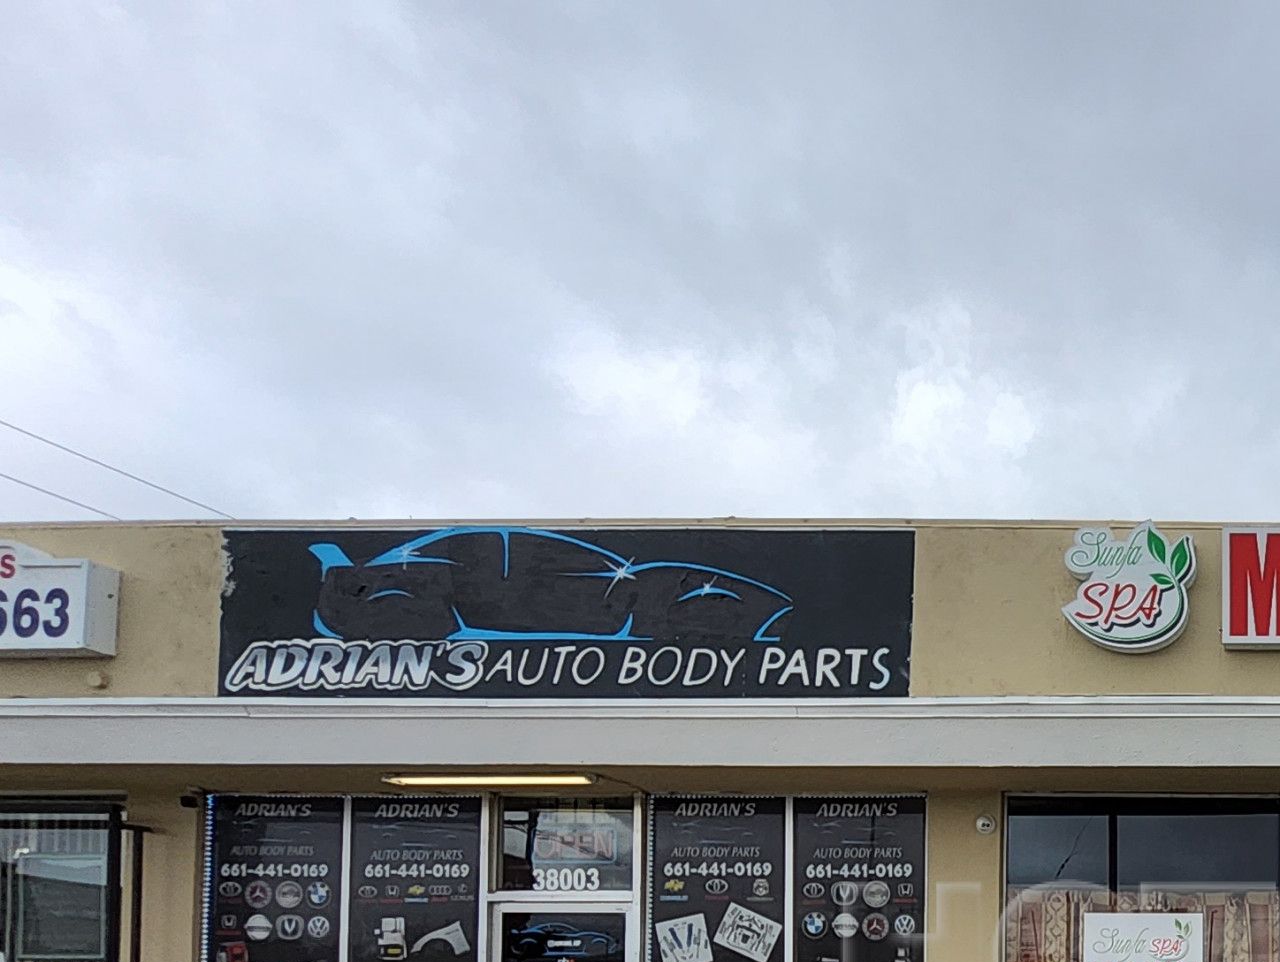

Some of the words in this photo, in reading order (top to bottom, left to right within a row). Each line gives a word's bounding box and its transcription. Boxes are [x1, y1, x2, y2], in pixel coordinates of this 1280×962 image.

[1075, 583, 1160, 626] SPA
[225, 639, 488, 691] ADRIAN'S
[485, 645, 605, 685] AUTO
[618, 647, 745, 686] BODY
[759, 647, 890, 690] PARTS
[235, 803, 312, 816] ADRIAN'S
[374, 803, 459, 818] ADRIAN'S
[675, 802, 756, 816] ADRIAN'S
[816, 803, 897, 817] ADRIAN'S
[370, 850, 399, 861] AUTO
[402, 850, 429, 861] BODY
[433, 850, 463, 861] PARTS
[671, 847, 699, 857] AUTO
[702, 847, 728, 857] BODY
[732, 847, 760, 857] PARTS
[813, 848, 841, 858] AUTO
[844, 848, 870, 858] BODY
[874, 848, 902, 858] PARTS
[221, 864, 328, 877] 661-441-0169
[365, 864, 470, 878] 661-441-0169
[664, 862, 772, 877] 661-441-0169
[806, 863, 913, 878] 661-441-0169
[533, 868, 600, 890] 38003
[1150, 938, 1183, 957] SPA
